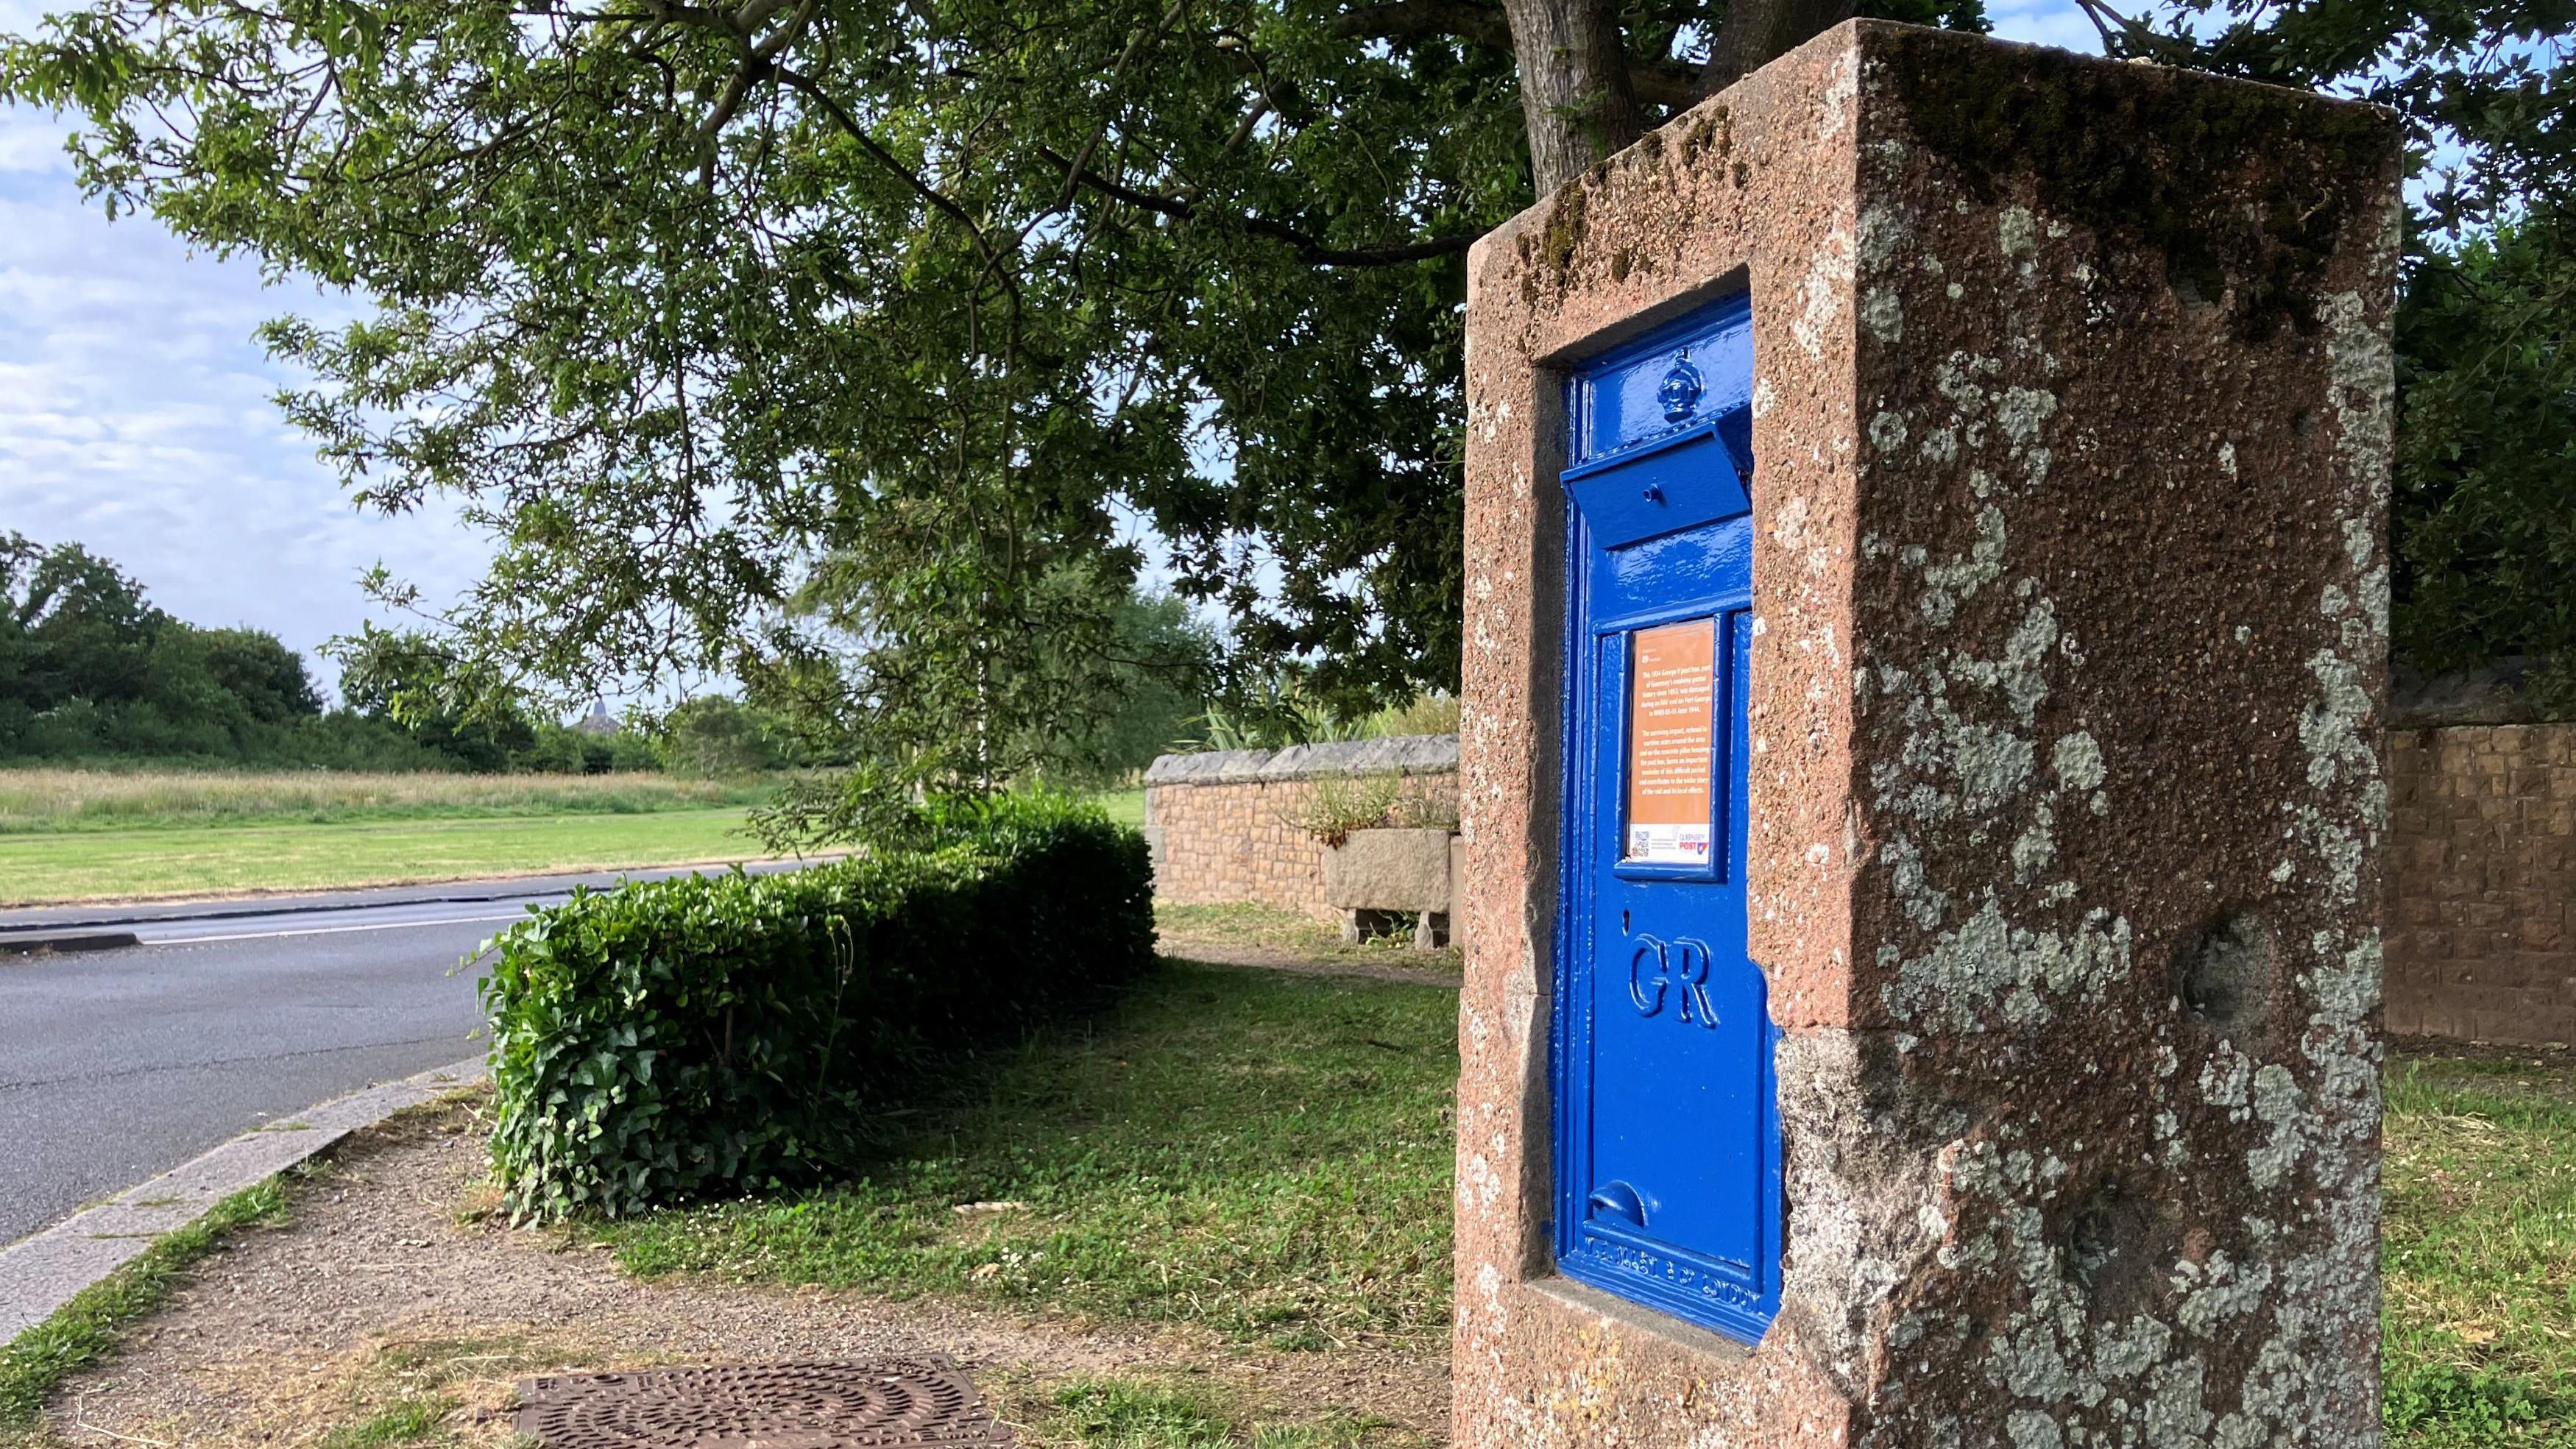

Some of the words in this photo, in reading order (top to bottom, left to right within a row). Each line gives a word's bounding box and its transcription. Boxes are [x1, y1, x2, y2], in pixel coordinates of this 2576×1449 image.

[1661, 668, 1677, 676] George
[1681, 667, 1690, 675] post
[1692, 674, 1706, 683] postal
[1694, 695, 1710, 704] George
[1630, 933, 1720, 1029] GR
